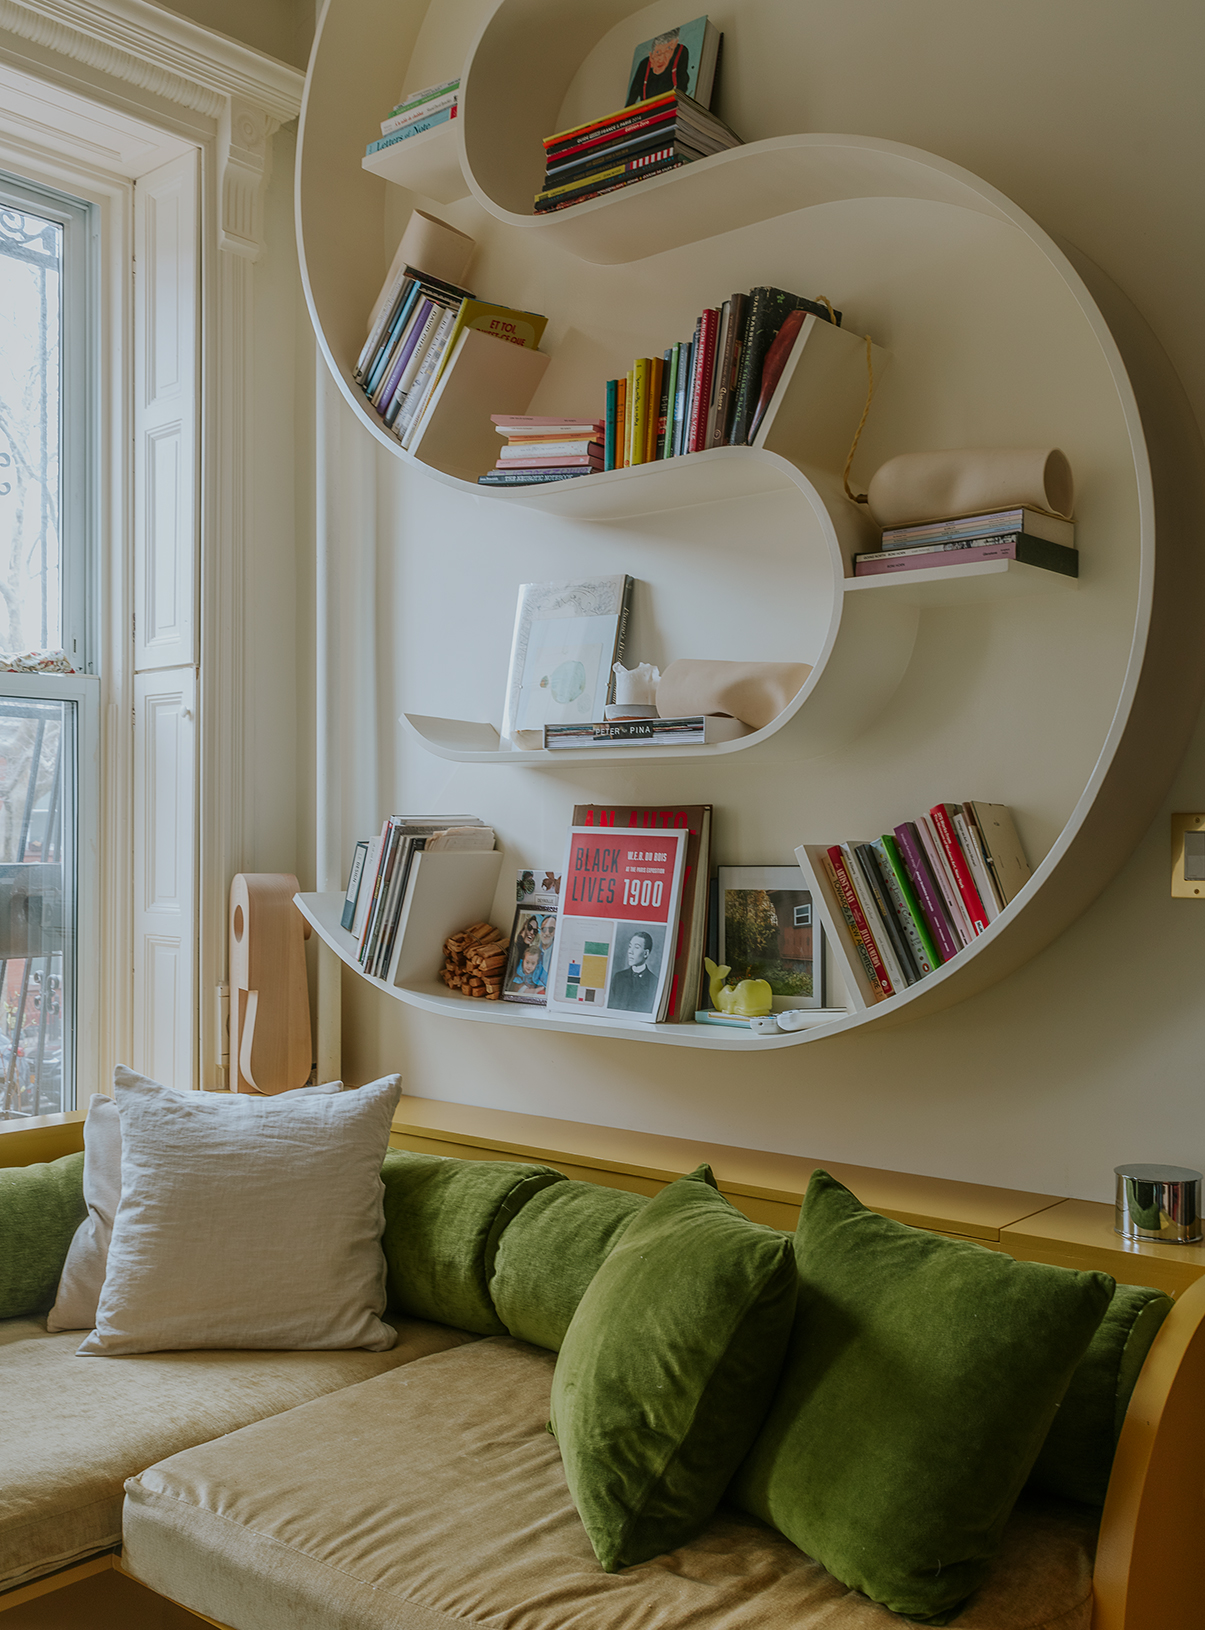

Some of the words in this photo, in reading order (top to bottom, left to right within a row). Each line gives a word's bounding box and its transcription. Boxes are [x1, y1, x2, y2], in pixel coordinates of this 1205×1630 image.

[424, 310, 437, 333] DAVID
[490, 320, 500, 330] ET
[746, 315, 756, 346] BARBER
[412, 333, 427, 359] CHANG
[739, 367, 748, 394] THIRD
[734, 396, 743, 422] PLATE
[595, 727, 619, 736] PETER
[629, 725, 650, 734] PINA
[939, 819, 948, 833] Works
[956, 820, 964, 832] Design
[936, 821, 945, 839] Museum
[944, 844, 954, 860] Modern
[576, 848, 620, 873] BLACK
[627, 852, 644, 861] W.E.B.
[654, 852, 668, 862] BOIS
[350, 860, 362, 883] DESIGN
[572, 876, 616, 904] LIVES
[623, 878, 664, 908] 1900
[836, 867, 851, 891] ARTIST'S
[844, 890, 855, 903] WAY
[880, 858, 890, 870] The
[885, 869, 896, 886] Secret
[892, 887, 902, 902] Lives
[901, 908, 912, 925] Color
[832, 879, 850, 913] TOWARDS
[848, 920, 860, 937] NEW
[855, 937, 880, 990] ARCHITECTURE
[859, 928, 872, 944] JULIA
[865, 942, 881, 968] CAMERON
